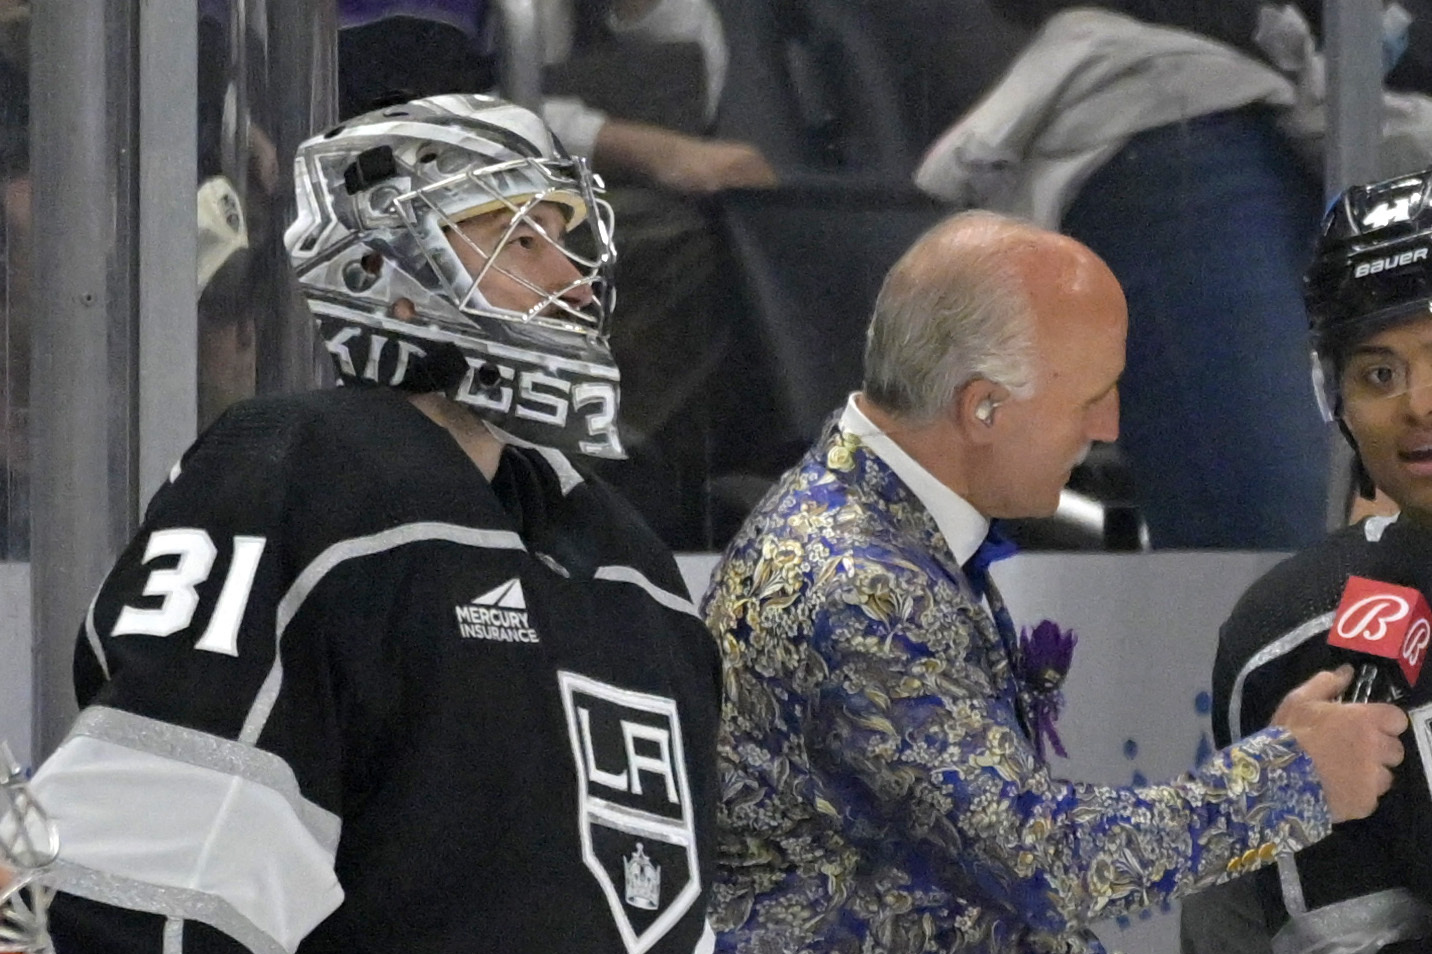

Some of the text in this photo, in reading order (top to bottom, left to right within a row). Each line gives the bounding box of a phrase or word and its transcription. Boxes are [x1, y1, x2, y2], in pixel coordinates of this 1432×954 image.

[110, 527, 268, 657] 31
[455, 605, 529, 629] MERCURY
[460, 623, 540, 643] INSURANCE
[578, 707, 679, 803] LA
